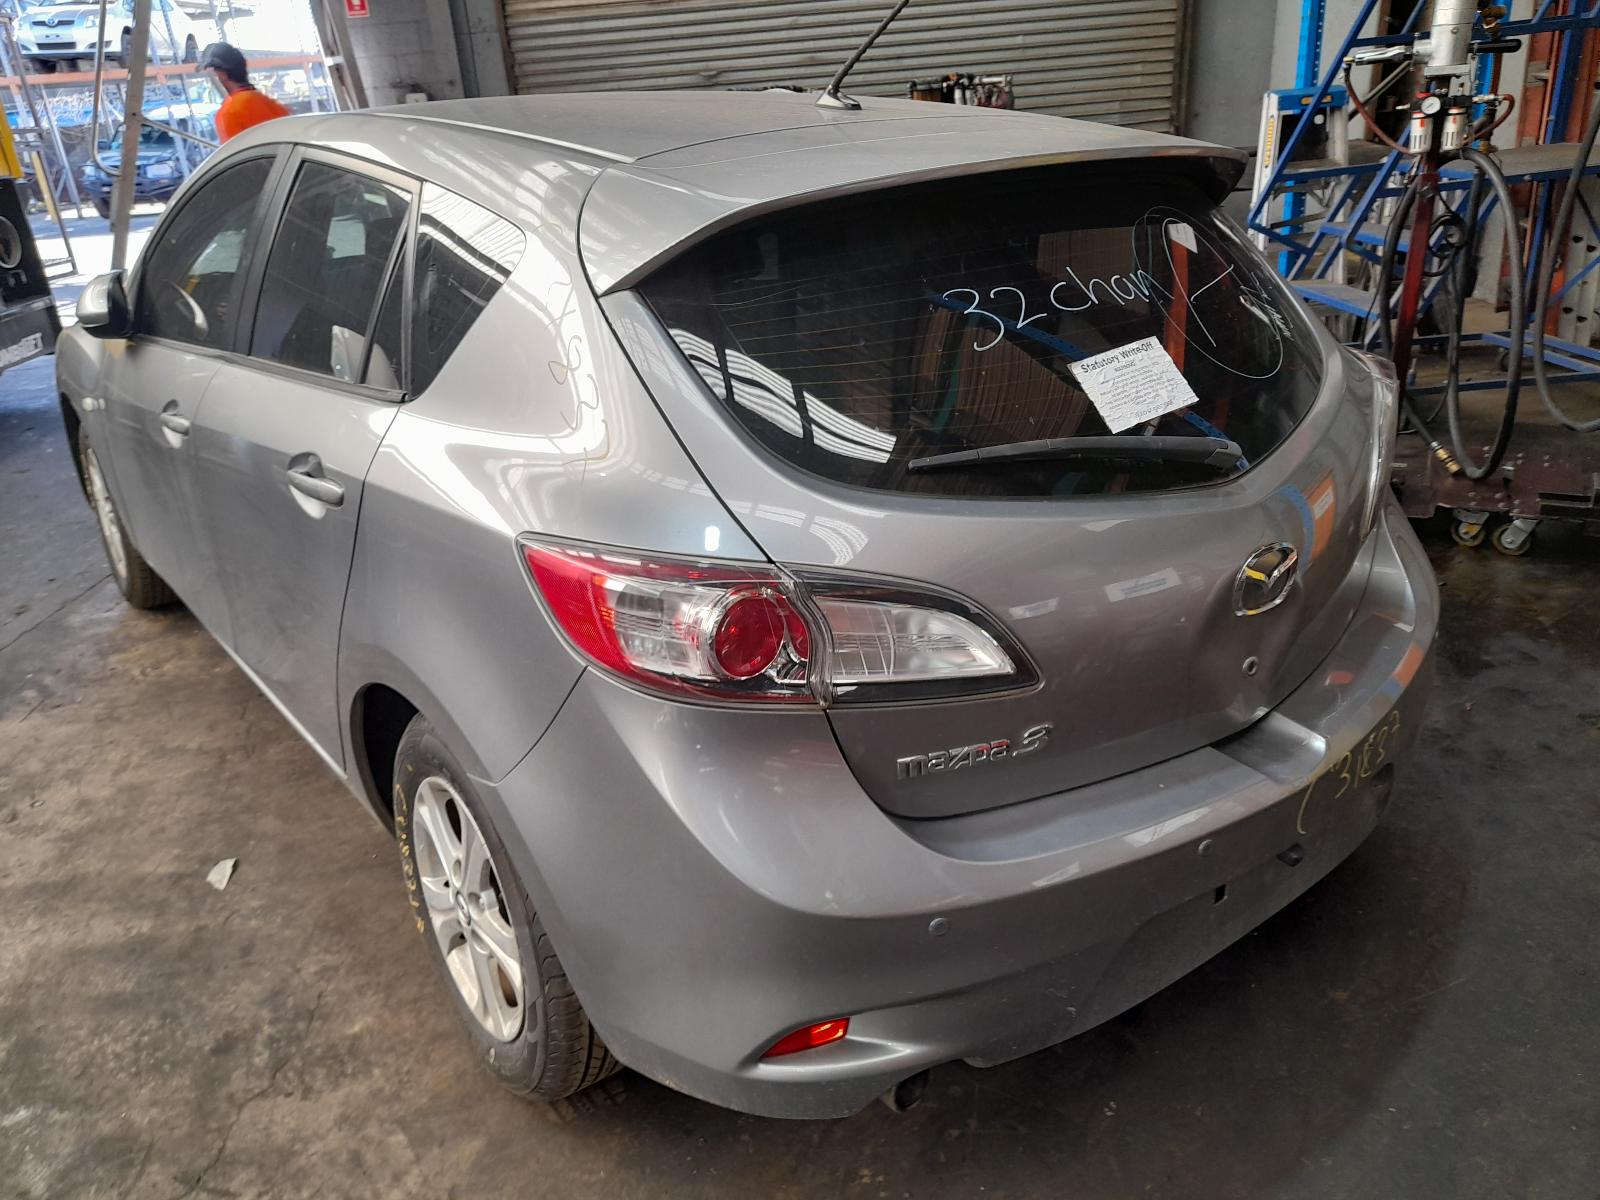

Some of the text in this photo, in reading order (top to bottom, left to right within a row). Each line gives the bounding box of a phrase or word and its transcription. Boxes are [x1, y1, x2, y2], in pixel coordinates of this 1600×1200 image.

[942, 286, 1047, 352] 32
[1080, 353, 1120, 374] Statutory
[1119, 341, 1154, 360] Write-Off
